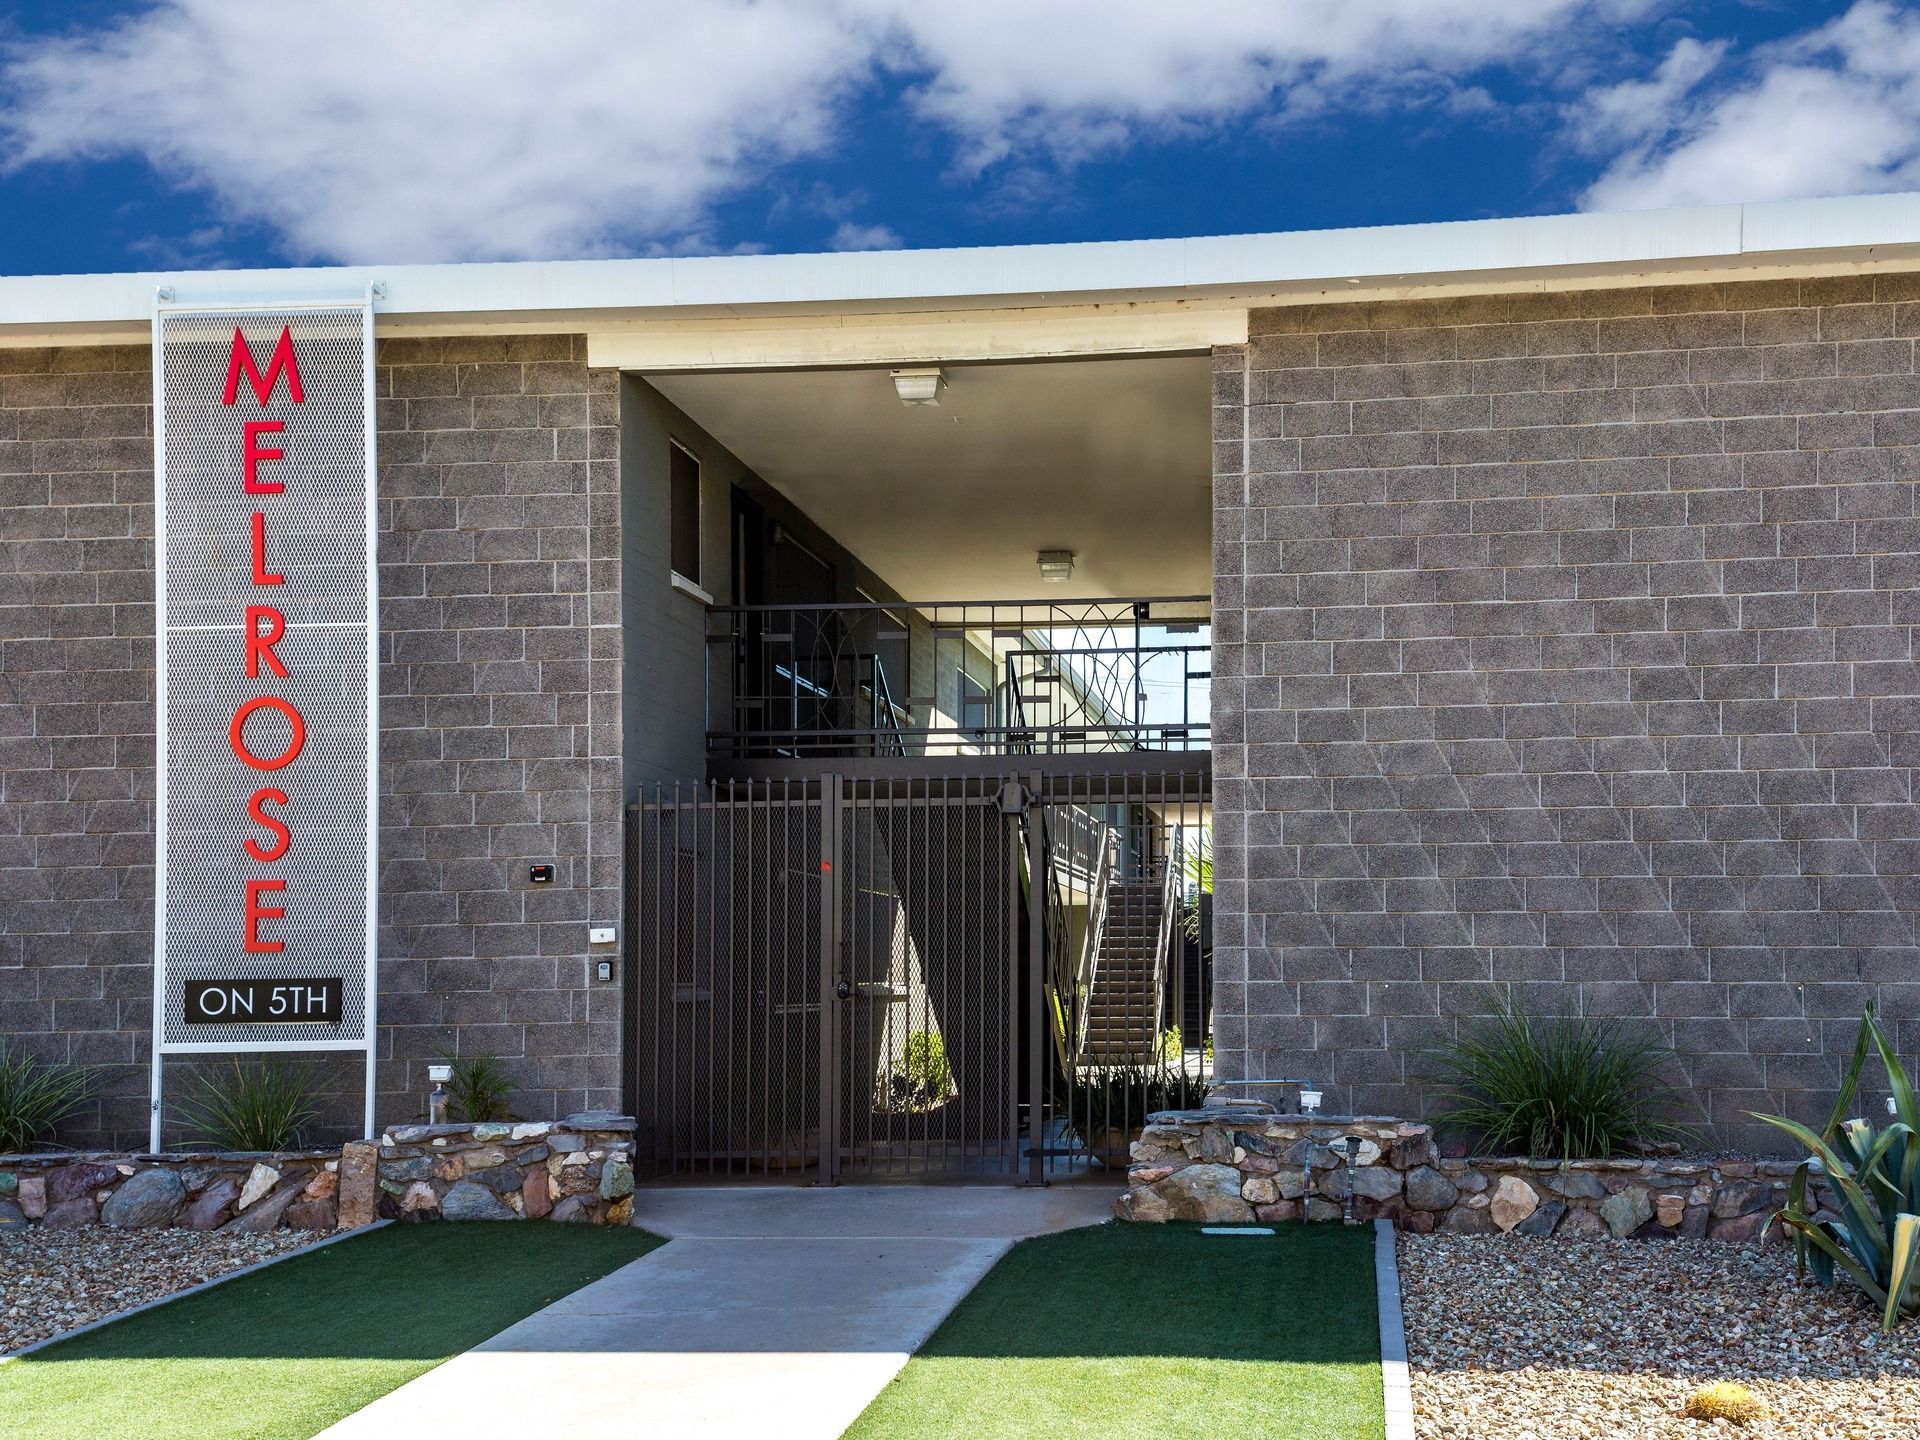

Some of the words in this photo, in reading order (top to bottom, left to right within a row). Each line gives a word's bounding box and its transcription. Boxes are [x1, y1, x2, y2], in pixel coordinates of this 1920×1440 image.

[221, 325, 305, 955] MELROSE
[199, 987, 253, 1016] ON
[268, 986, 327, 1015] 5TH
